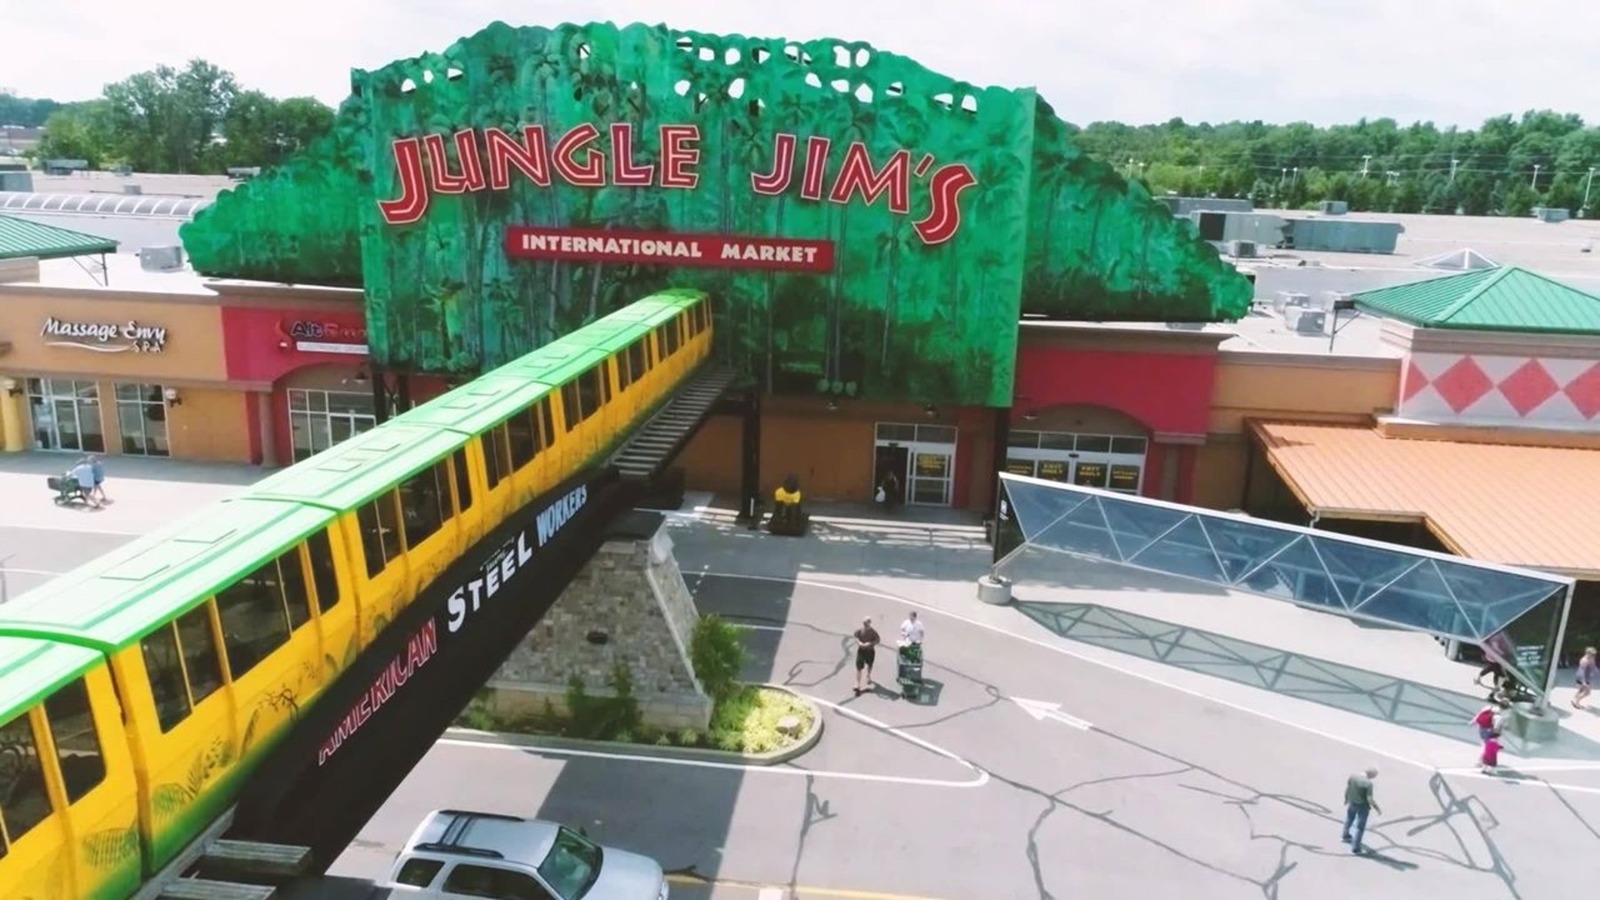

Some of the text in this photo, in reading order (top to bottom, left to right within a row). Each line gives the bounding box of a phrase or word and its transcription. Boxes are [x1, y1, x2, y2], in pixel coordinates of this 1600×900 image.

[378, 122, 977, 245] JUNGLE JIM'S
[521, 233, 818, 264] INTERNATIONAL MARKET
[40, 316, 167, 345] Massage Envy
[131, 339, 163, 353] SPA
[318, 483, 588, 767] AMERICAN STEEL WORKERS
